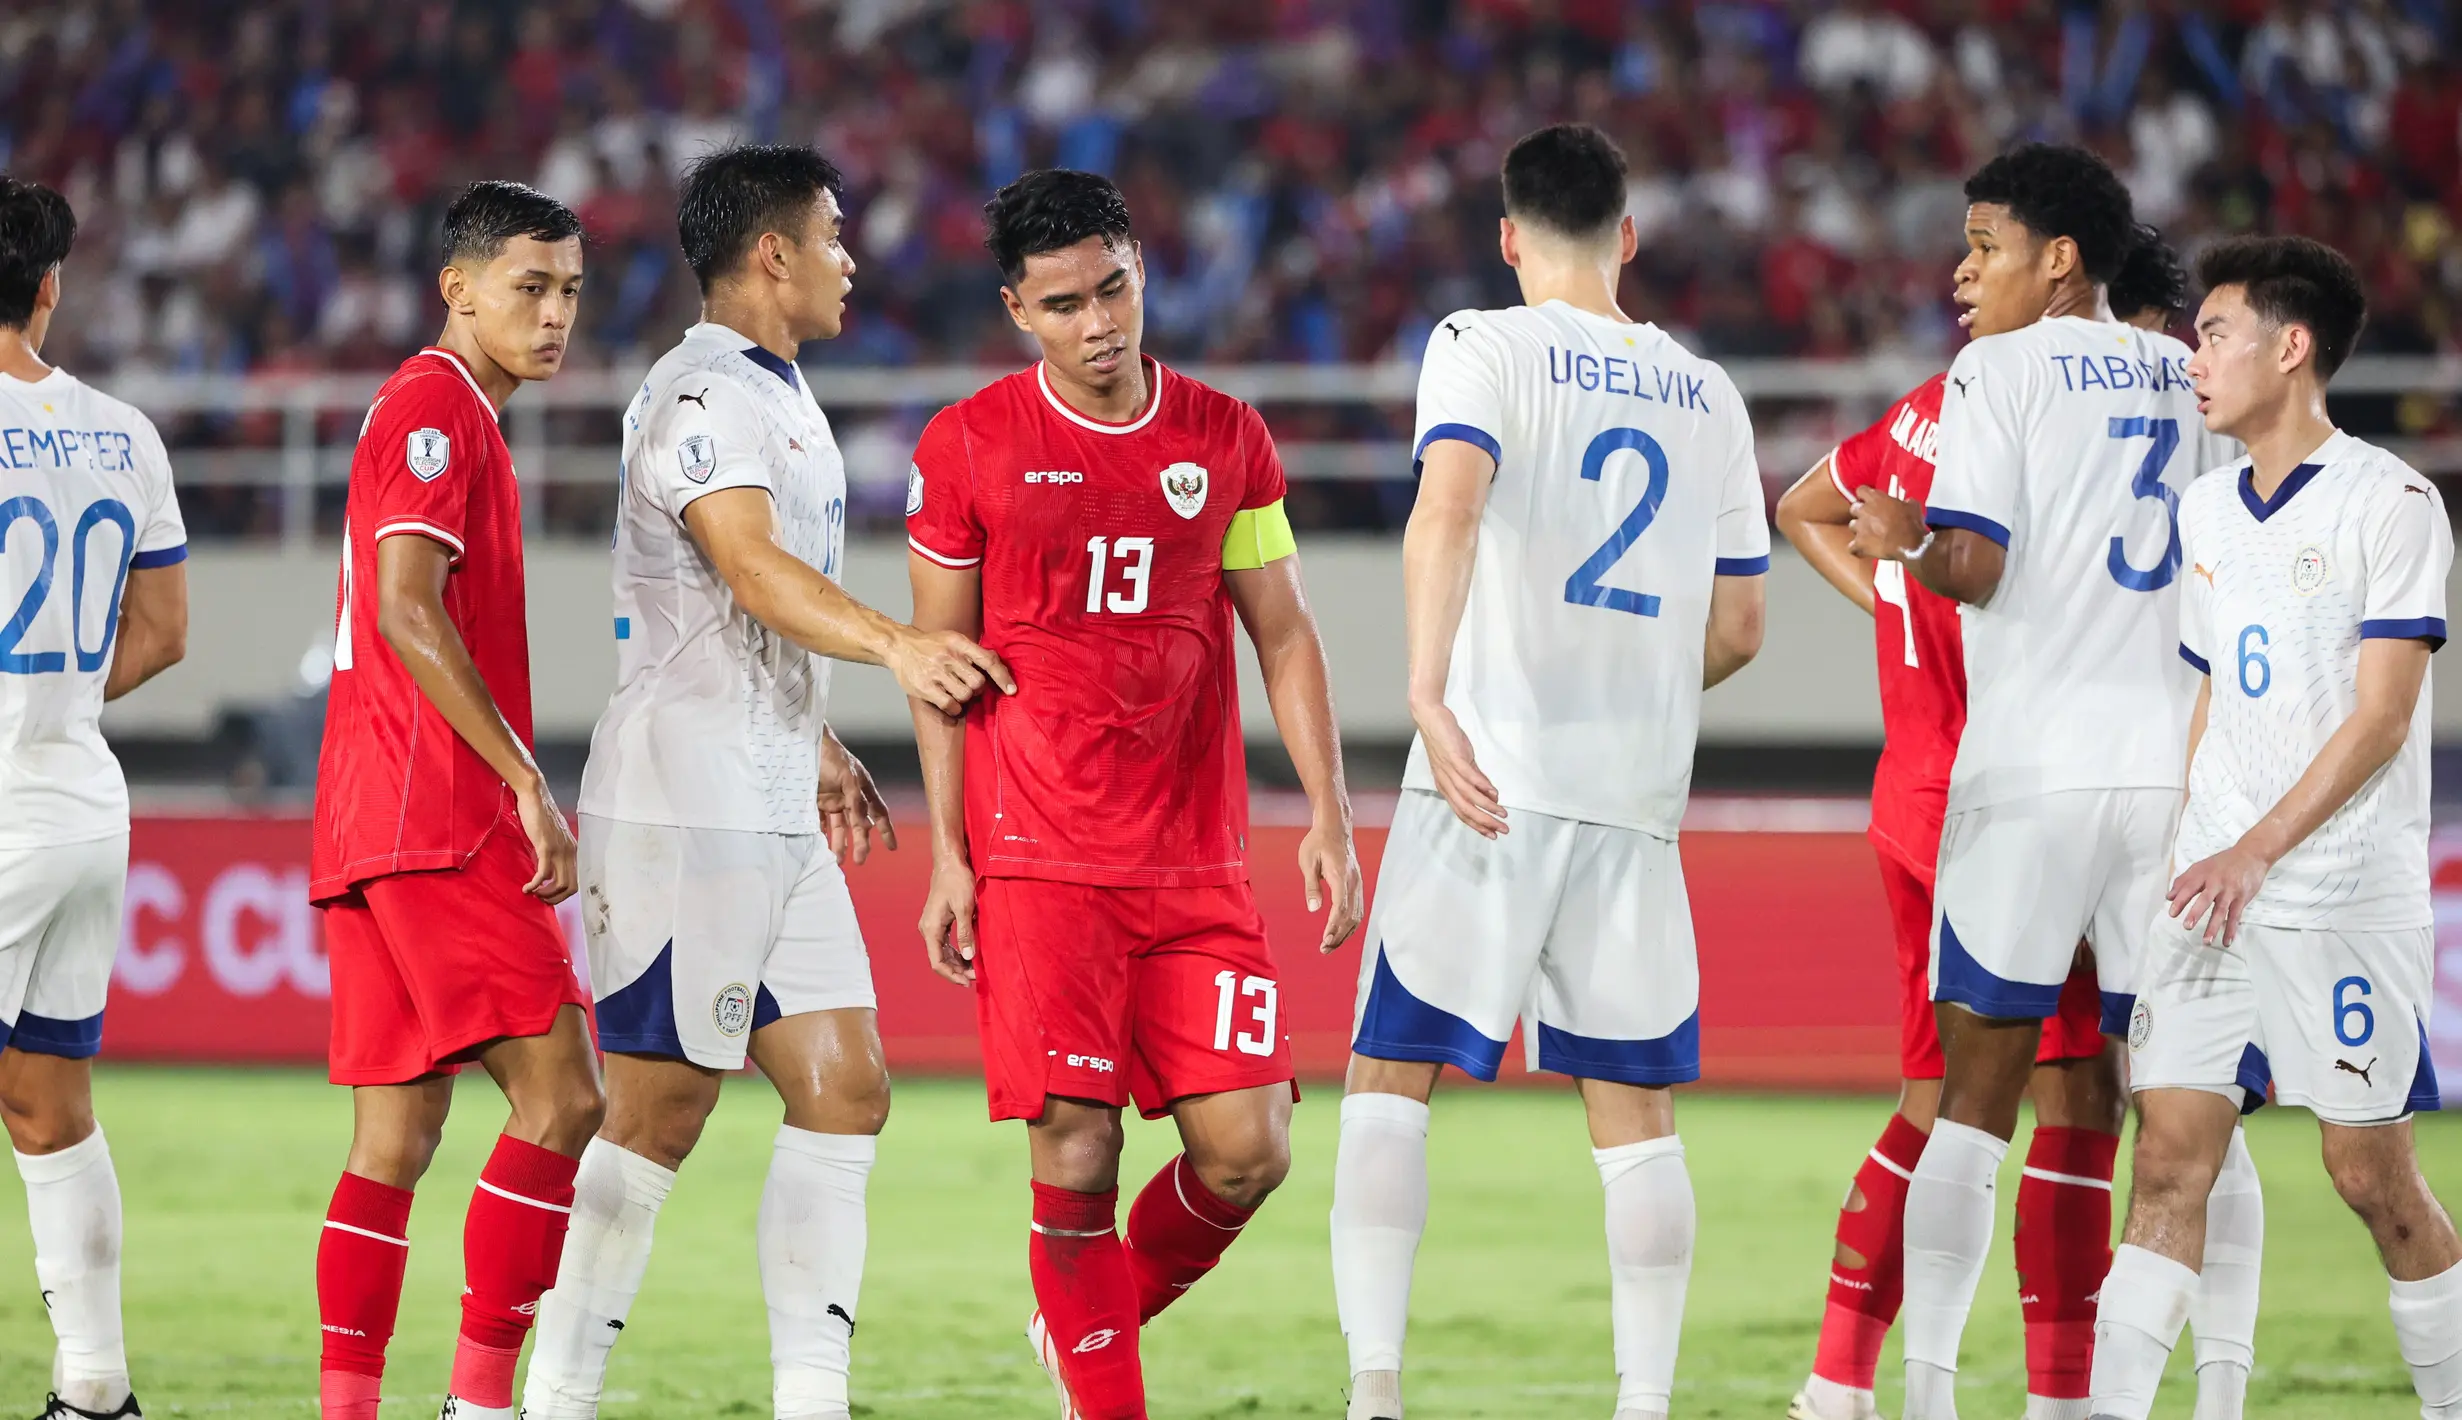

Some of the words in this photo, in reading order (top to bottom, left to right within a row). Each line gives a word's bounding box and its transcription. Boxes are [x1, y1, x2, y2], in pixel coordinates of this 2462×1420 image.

[1549, 346, 1710, 414] UGELVIK
[1024, 471, 1083, 485] erspo
[2107, 416, 2183, 592] 3
[1564, 427, 1669, 618] 2
[0, 495, 135, 674] 20
[1086, 536, 1154, 614] 13
[2238, 623, 2271, 698] 6
[1213, 970, 1277, 1057] 13
[2333, 976, 2374, 1046] 6
[1067, 1054, 1114, 1072] erspo
